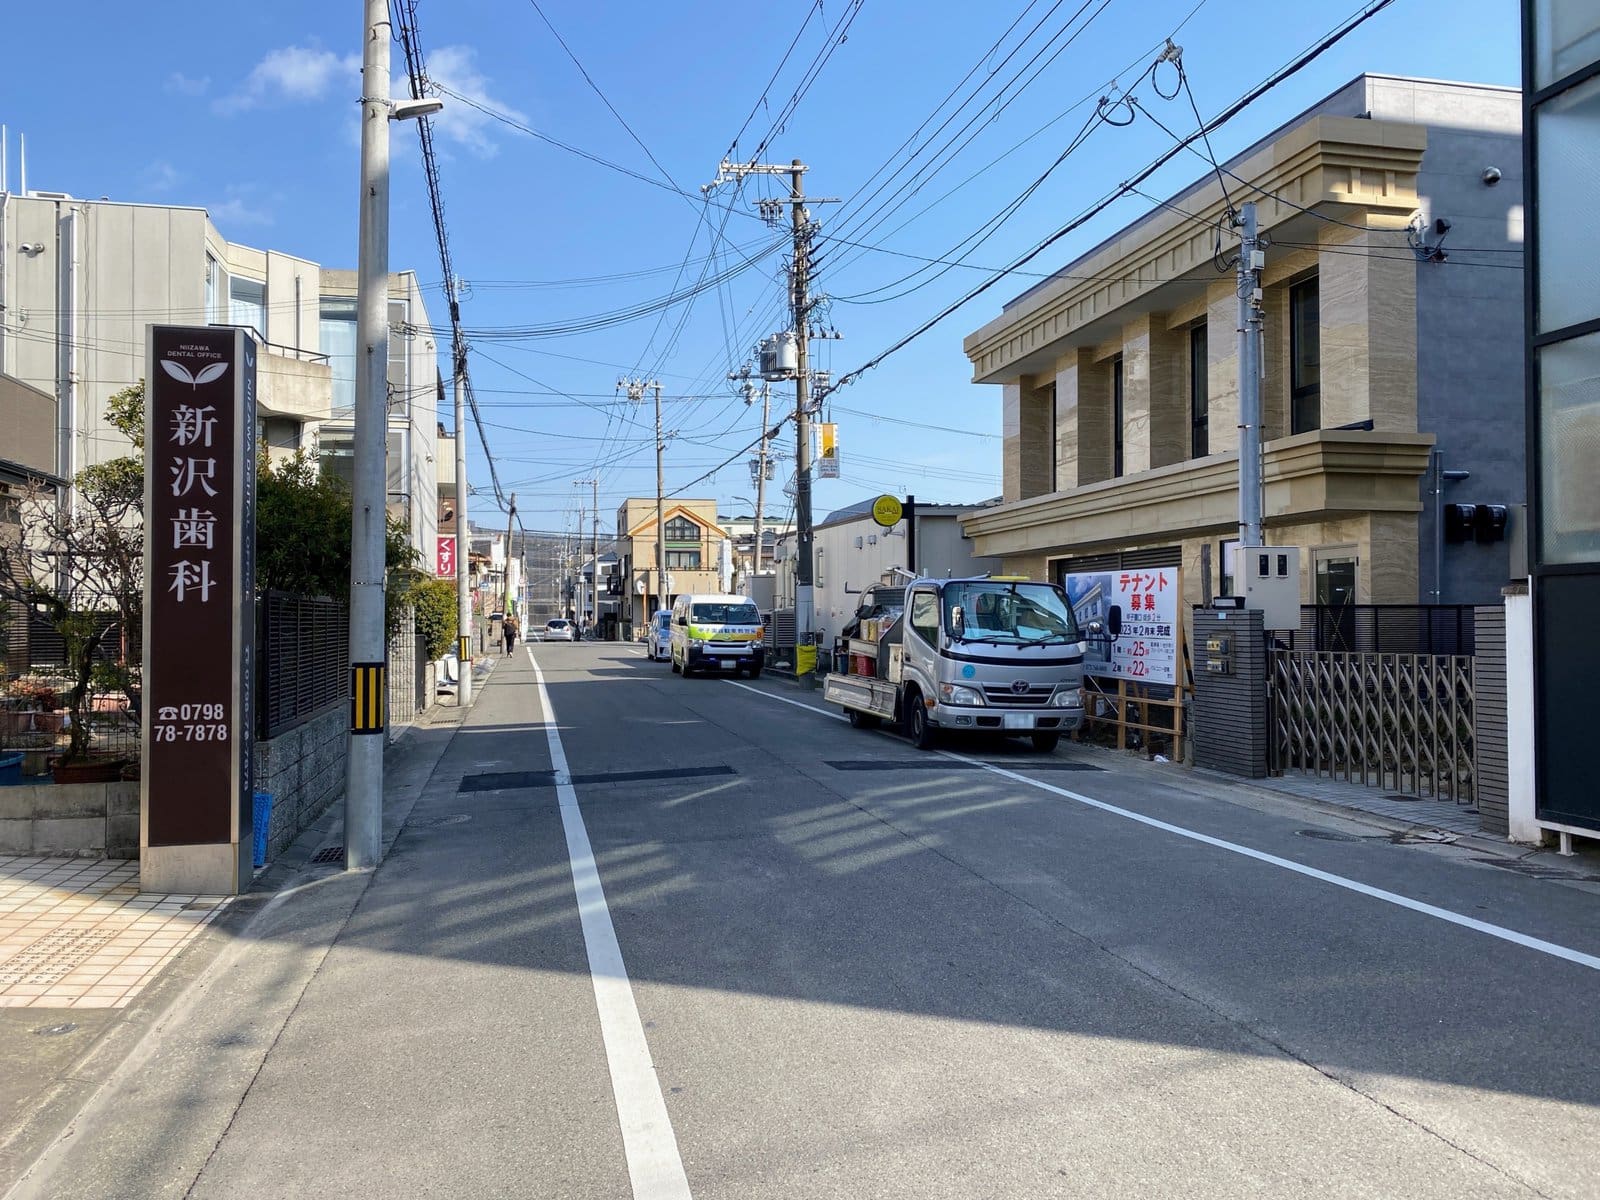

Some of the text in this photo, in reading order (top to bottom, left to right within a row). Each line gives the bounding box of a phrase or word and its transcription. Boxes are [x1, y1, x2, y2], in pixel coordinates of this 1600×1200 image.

[168, 404, 219, 602] 新沢歯科
[440, 539, 452, 575] くすり
[1120, 572, 1168, 592] テナント
[1131, 594, 1156, 611] 募集
[1119, 624, 1171, 637] 023年2月末完成
[180, 704, 224, 720] 0798
[154, 724, 228, 741] 78-7878
